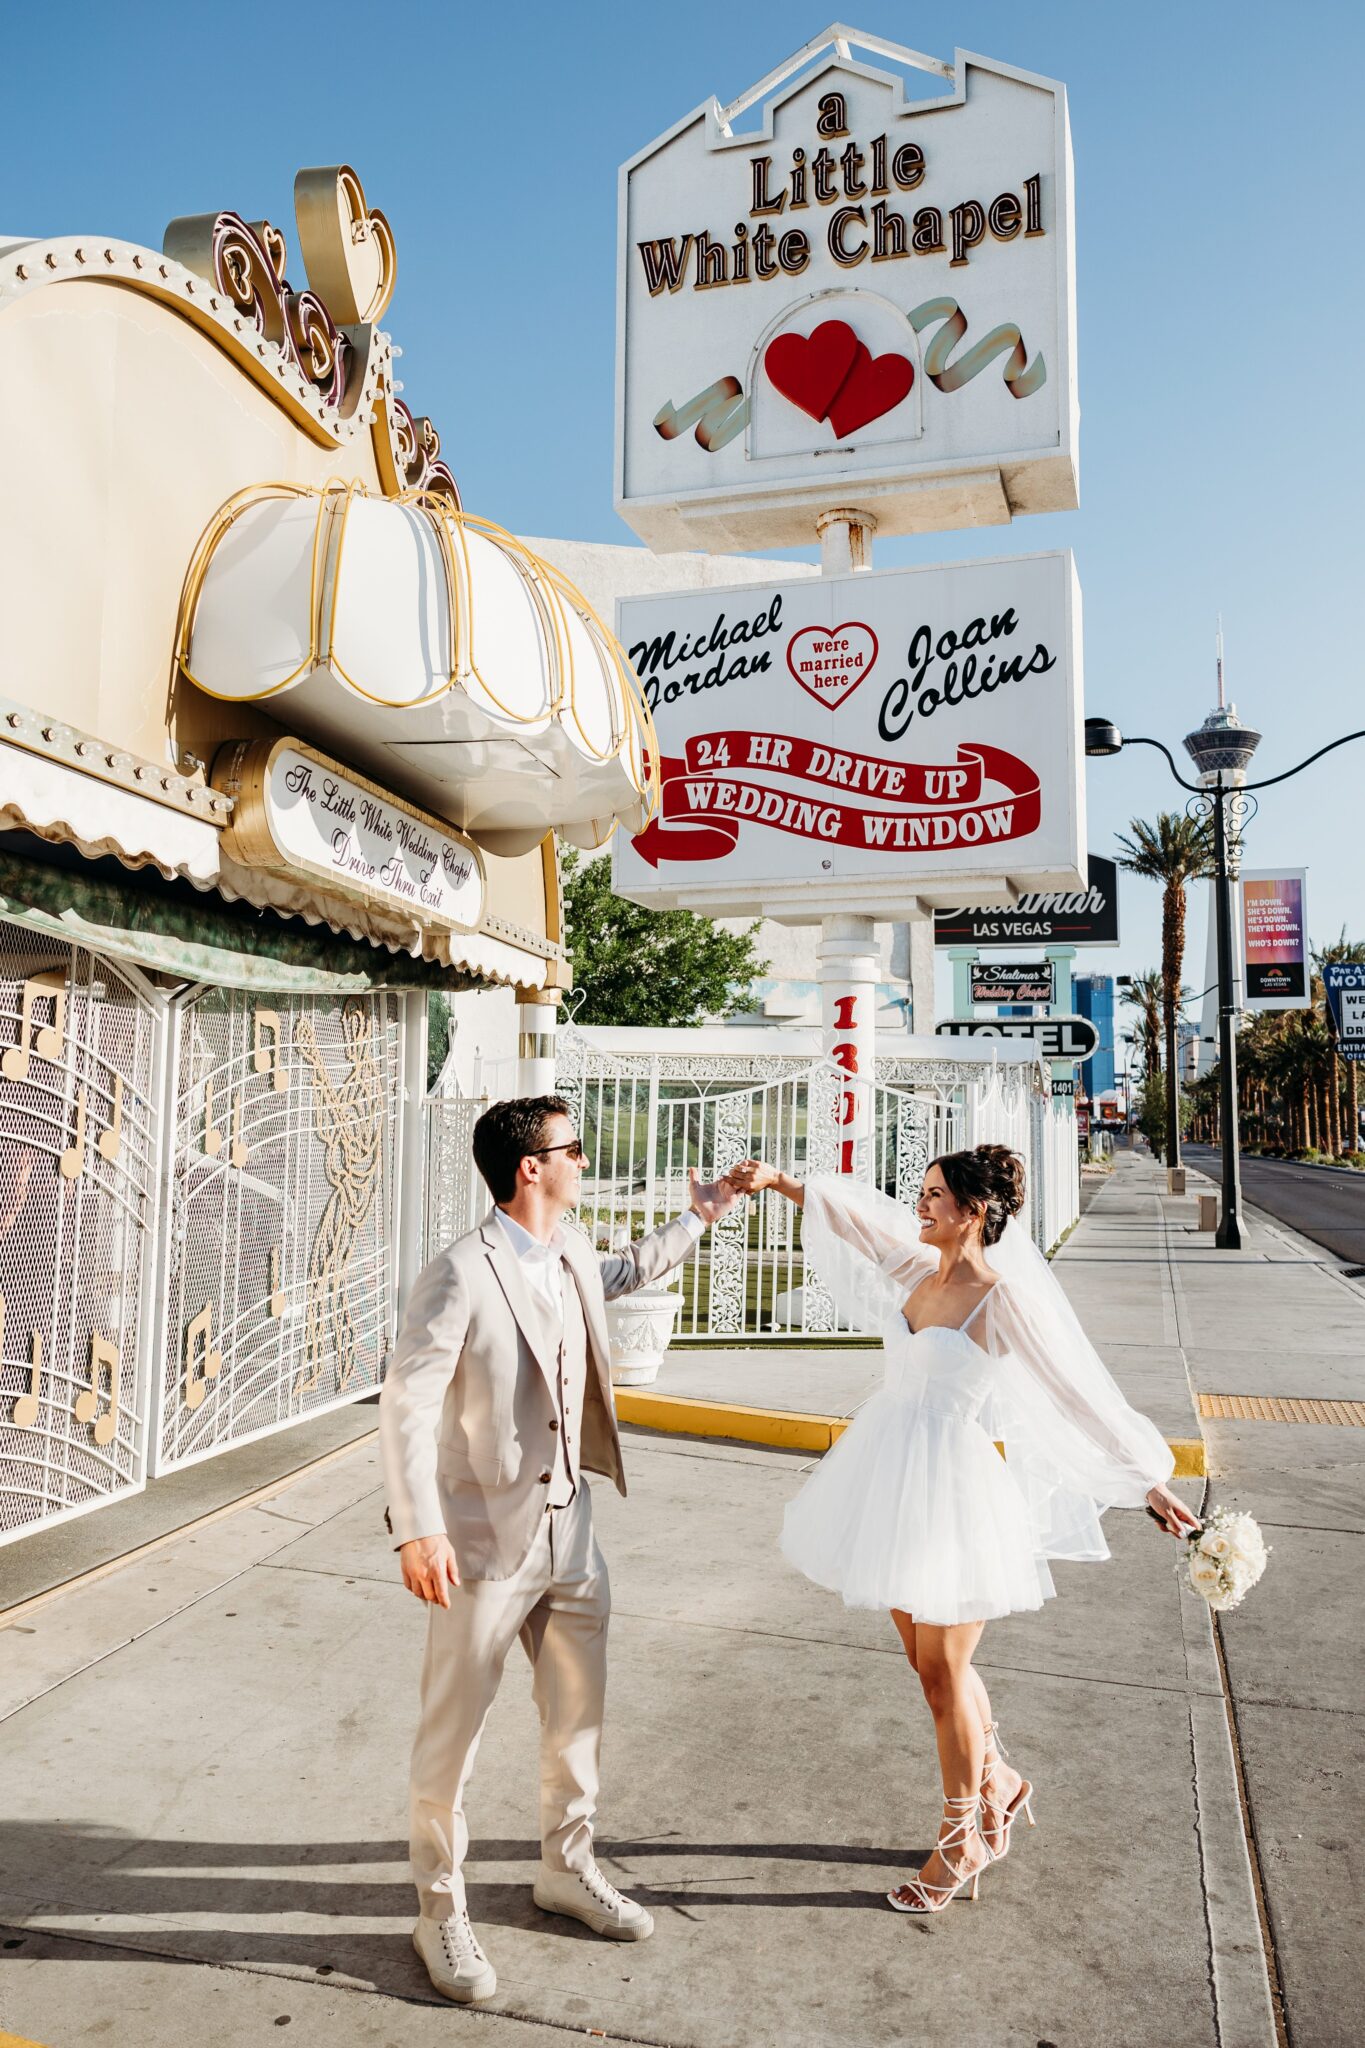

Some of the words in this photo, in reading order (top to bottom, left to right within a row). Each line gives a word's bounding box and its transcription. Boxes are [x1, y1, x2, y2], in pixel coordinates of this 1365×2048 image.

[816, 92, 849, 138] a
[750, 133, 925, 217] Little
[637, 222, 810, 297] White
[828, 173, 1045, 267] Chapel
[628, 594, 783, 677] Michael
[812, 639, 849, 653] were
[908, 607, 1019, 691] Joan
[799, 652, 864, 672] married
[641, 650, 772, 724] Jordan
[813, 674, 849, 688] here
[878, 643, 1056, 742] Collins
[697, 737, 730, 767] 24
[749, 736, 793, 768] HR
[808, 747, 906, 795] DRIVE
[924, 769, 968, 799] UP
[685, 782, 842, 838] WEDDING
[862, 805, 1014, 846] WINDOW
[285, 764, 317, 803] The
[320, 778, 356, 823] Little
[360, 799, 393, 842] White
[396, 819, 439, 874] Wedding
[442, 843, 473, 885] Chapel
[331, 828, 376, 880] Drive
[380, 857, 416, 897] Thru
[420, 869, 444, 909] Exit
[1247, 899, 1258, 907] I'M
[1260, 898, 1284, 906] DOWN.
[1247, 907, 1266, 915] SHE'S
[1267, 907, 1292, 915] DOWN.
[973, 923, 999, 936] LAS
[1002, 922, 1052, 936] VEGAS
[1247, 916, 1263, 924] HE'S
[1275, 924, 1300, 932] DOWN.
[1248, 939, 1271, 947] WHO'S
[1272, 938, 1299, 947] DOWN?
[983, 966, 1040, 981] Shalimar
[974, 985, 1014, 1002] Wedding
[1016, 984, 1050, 1000] Chapel
[1052, 1081, 1073, 1094] 1401
